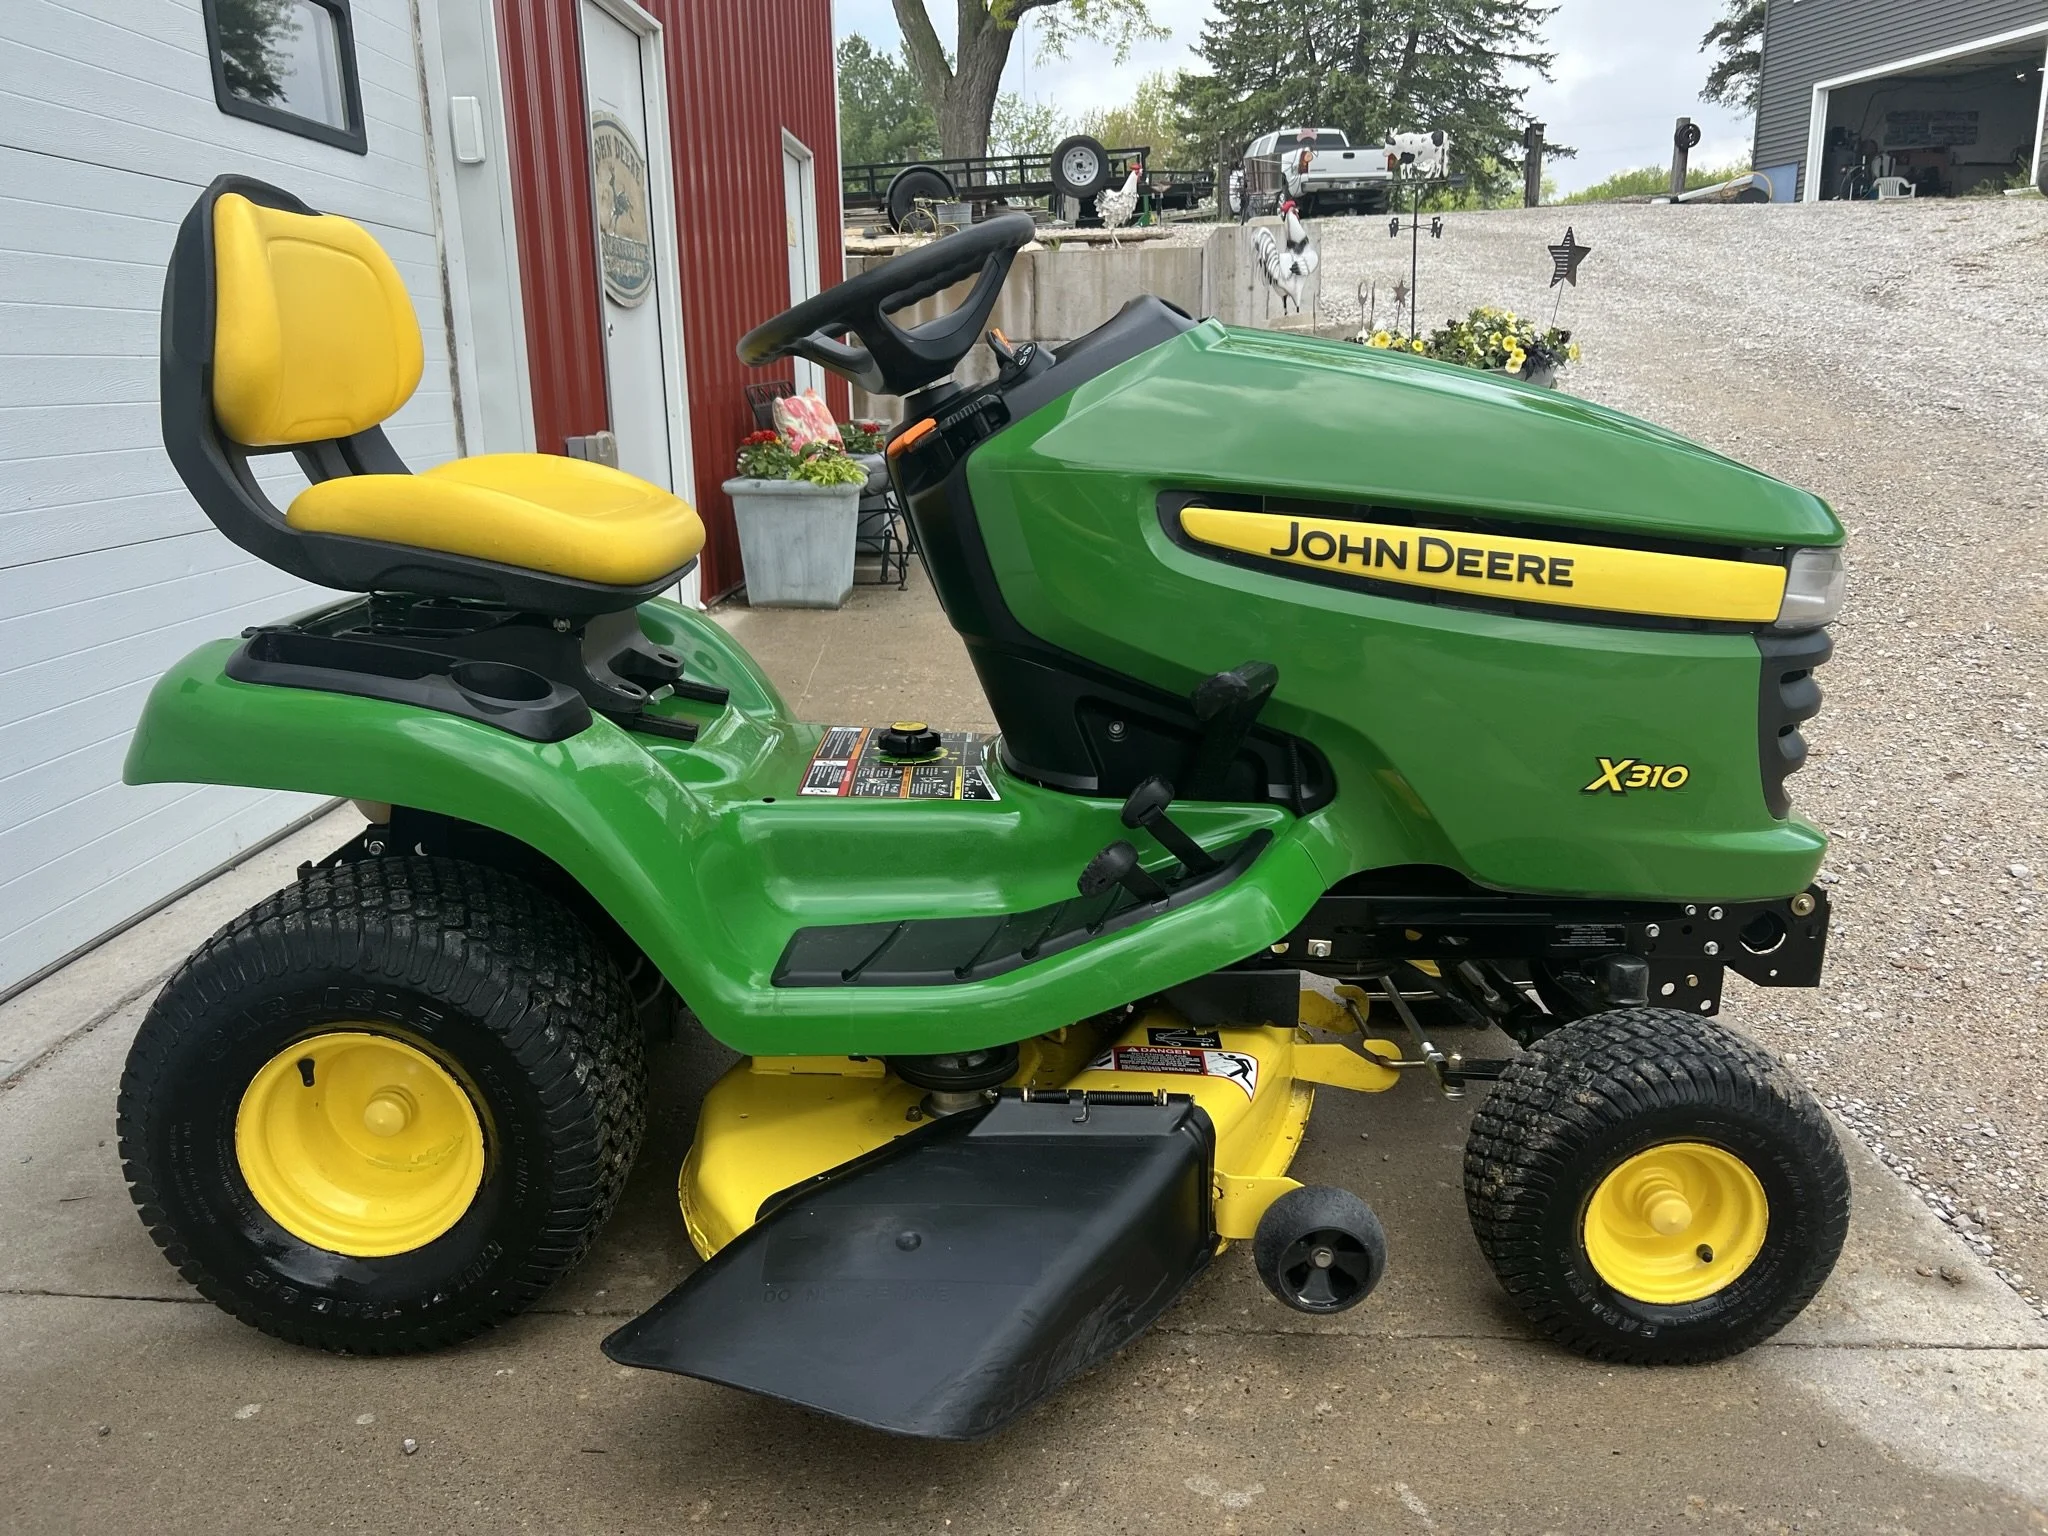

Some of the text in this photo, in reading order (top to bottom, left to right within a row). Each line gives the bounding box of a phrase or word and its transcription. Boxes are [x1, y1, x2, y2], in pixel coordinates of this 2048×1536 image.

[1270, 521, 1574, 588] JOHN DEERE
[1580, 756, 1690, 793] X310
[1140, 1047, 1191, 1055] DANGER
